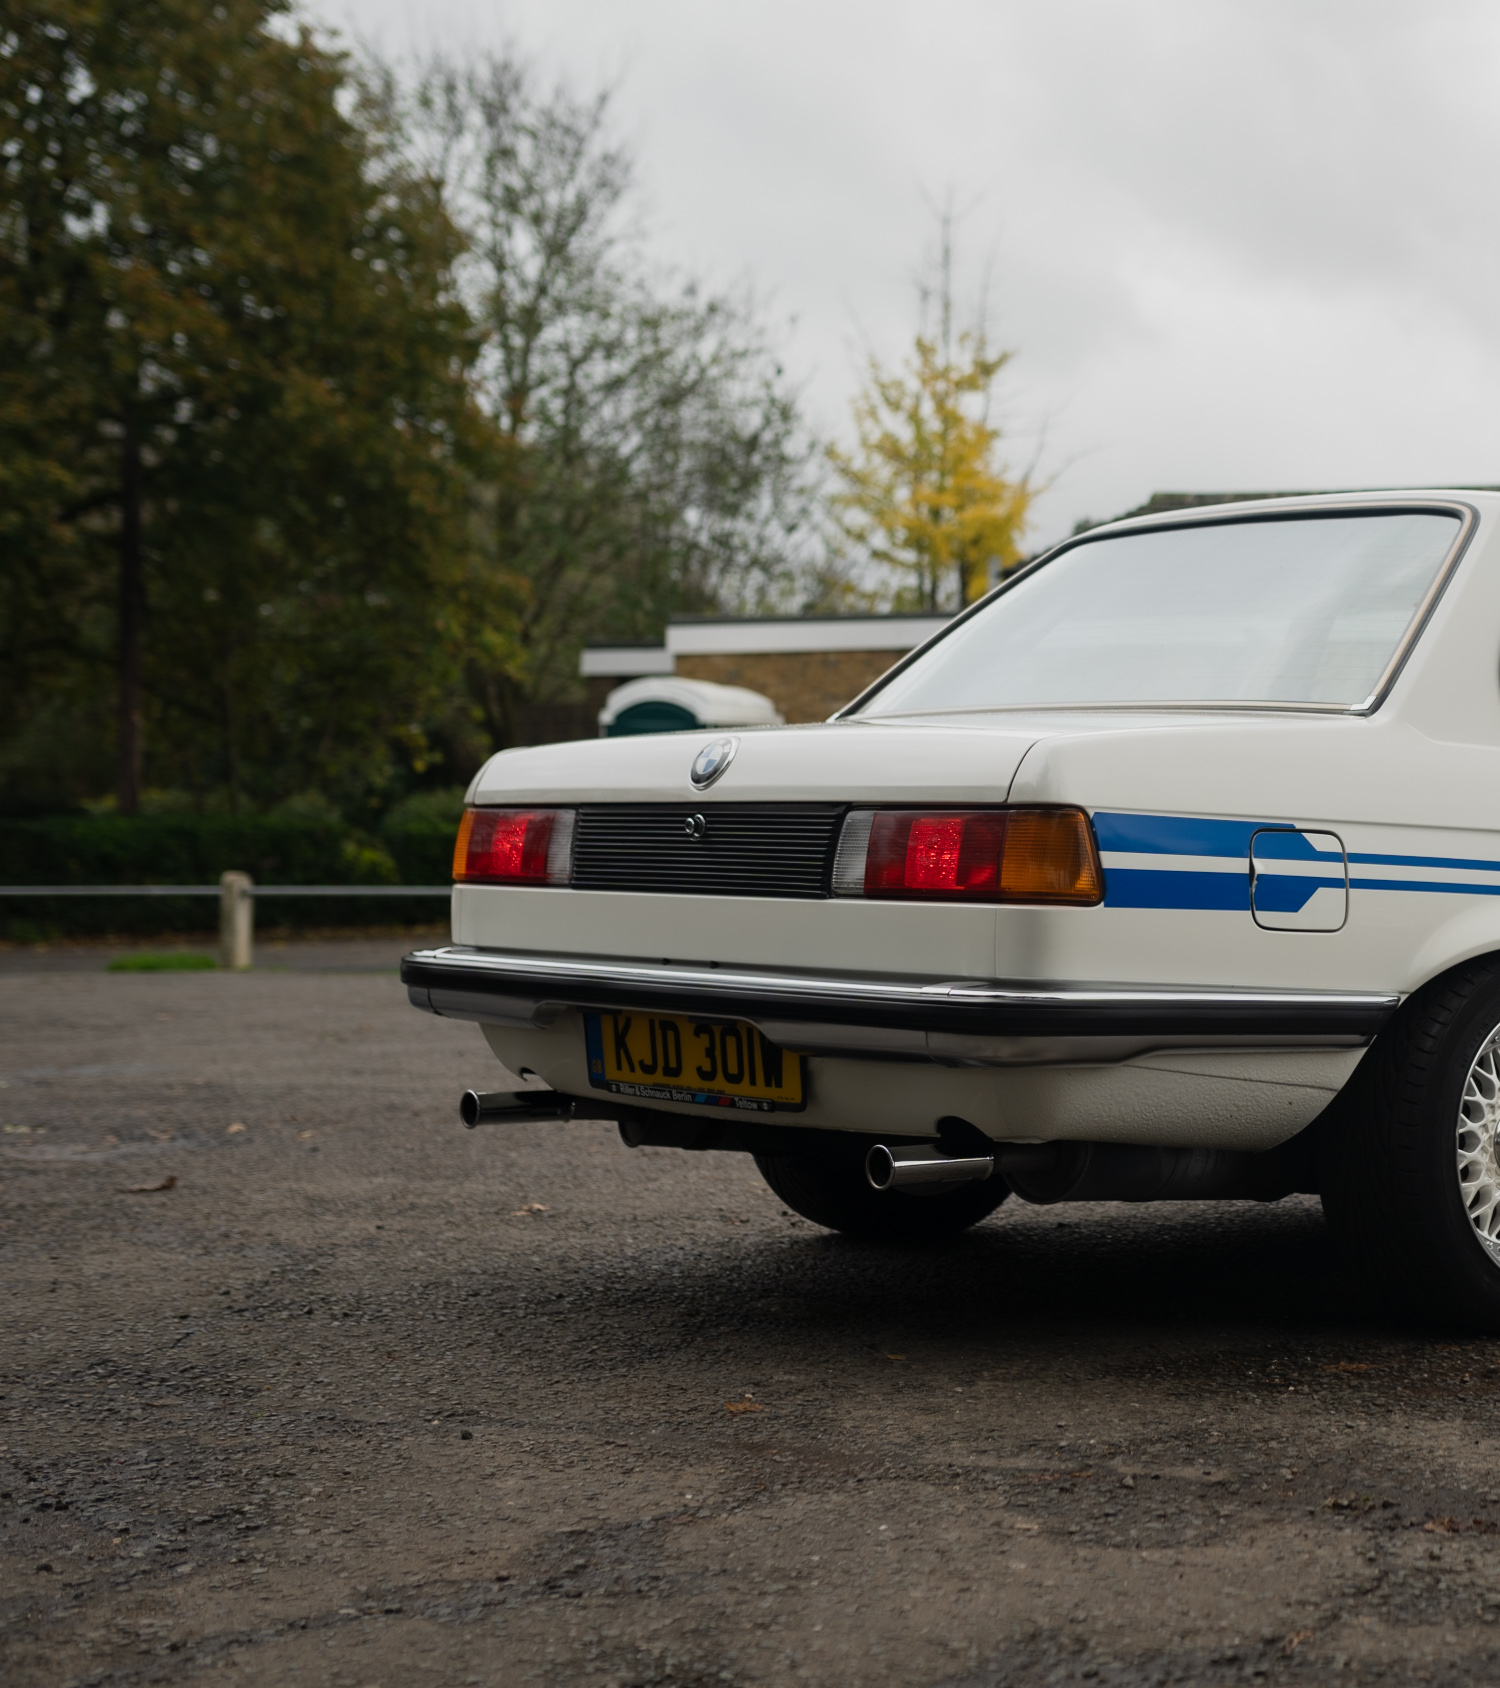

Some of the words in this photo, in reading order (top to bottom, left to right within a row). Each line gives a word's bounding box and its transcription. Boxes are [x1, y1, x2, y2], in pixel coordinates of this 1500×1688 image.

[612, 1014, 683, 1078] KJD
[694, 1022, 783, 1089] 301W
[640, 1087, 671, 1099] Schnauck
[672, 1089, 692, 1102] Berlin
[735, 1096, 758, 1109] Teltow
